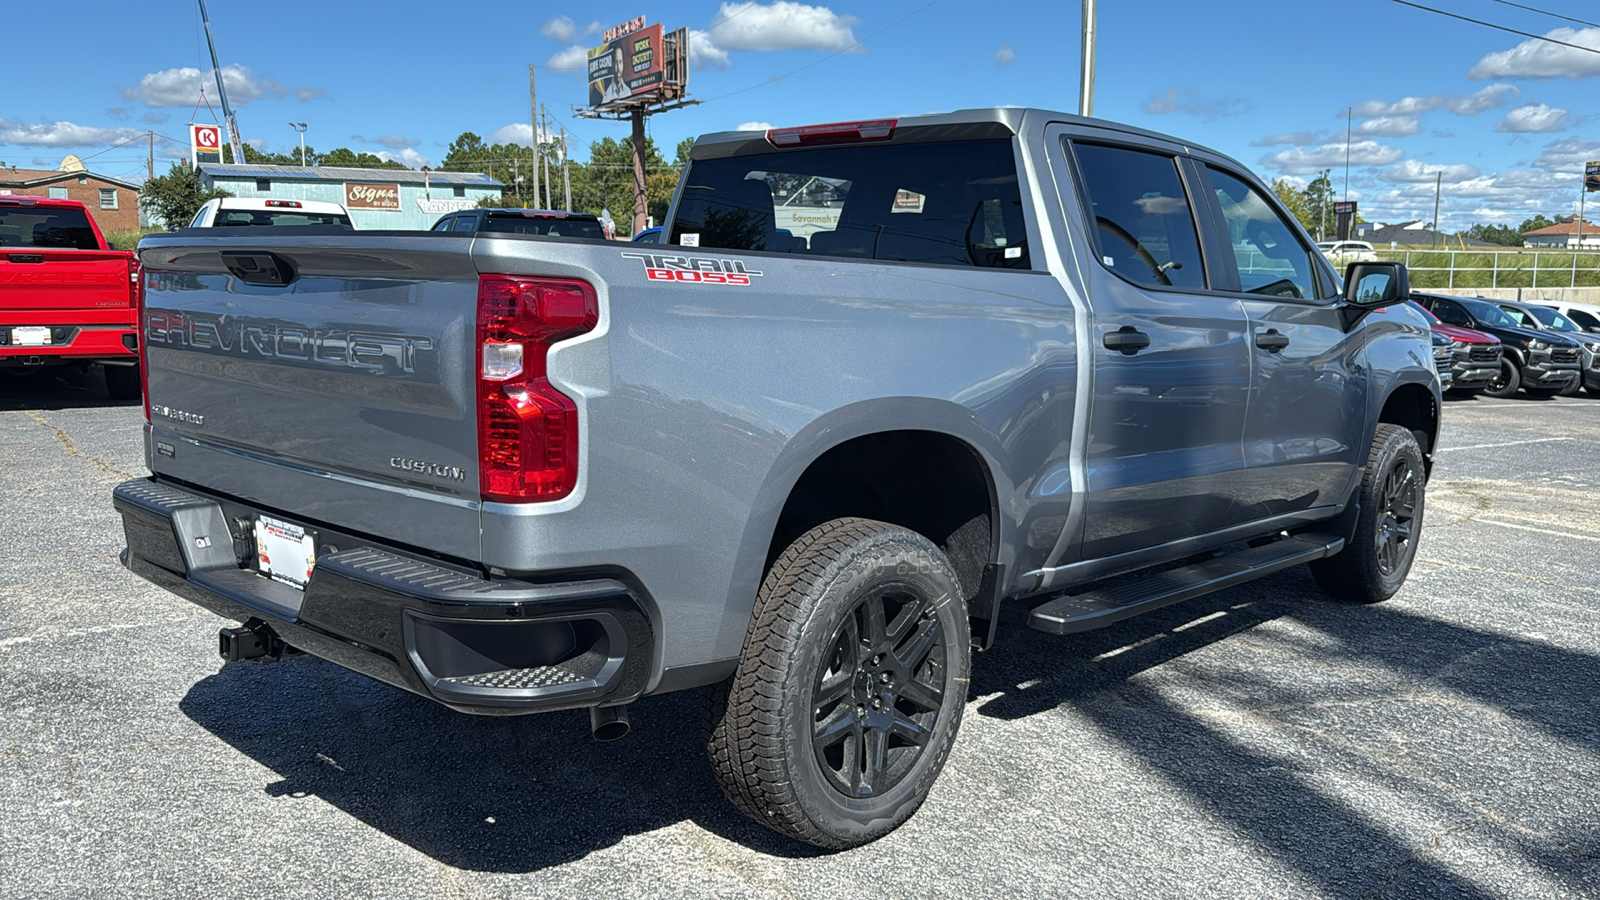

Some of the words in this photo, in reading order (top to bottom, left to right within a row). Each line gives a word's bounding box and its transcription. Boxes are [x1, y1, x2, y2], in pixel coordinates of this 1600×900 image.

[349, 185, 395, 203] Signs
[792, 213, 832, 224] Savannah
[621, 252, 764, 277] TRAIL
[646, 268, 751, 286] BOSS
[147, 313, 433, 373] CHEVROLET
[390, 457, 466, 480] CUSTOM
